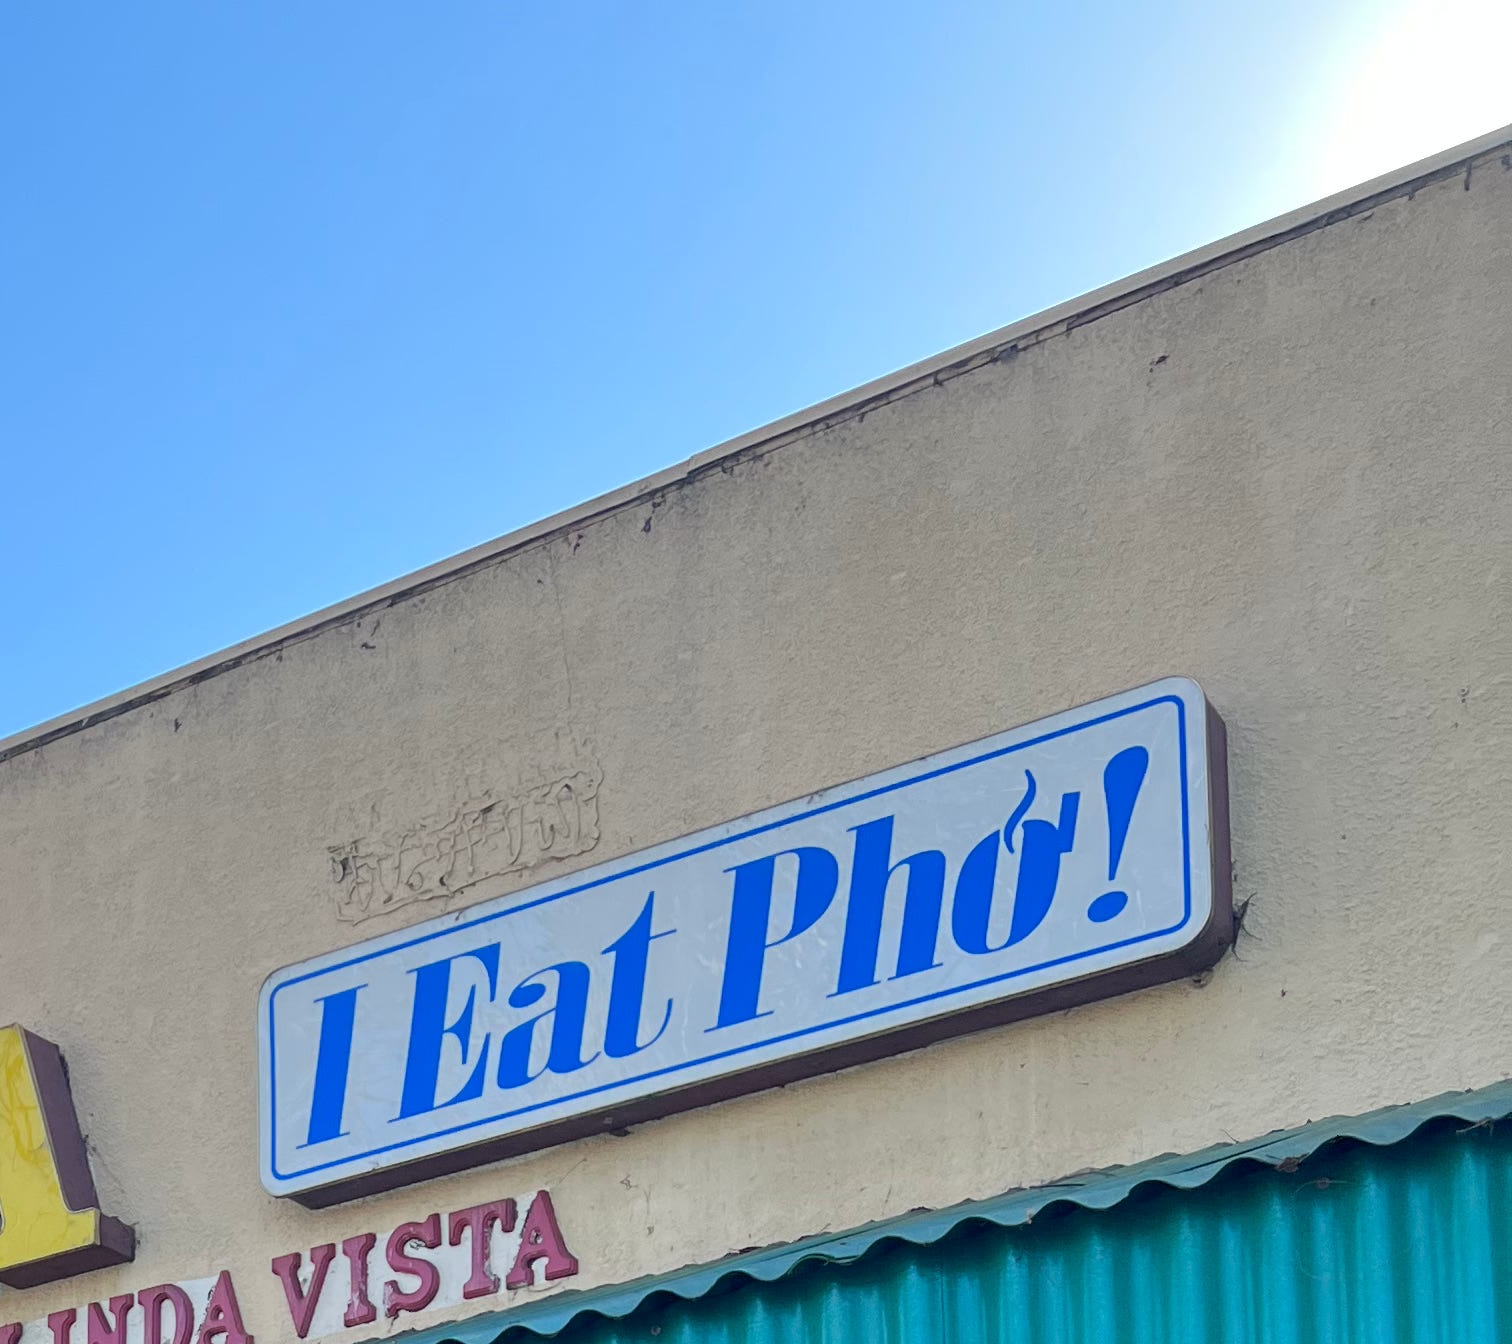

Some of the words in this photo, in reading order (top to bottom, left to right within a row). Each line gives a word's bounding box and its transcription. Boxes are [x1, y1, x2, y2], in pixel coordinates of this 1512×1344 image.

[295, 986, 369, 1149] I
[386, 889, 676, 1123] Eat
[271, 1190, 579, 1339] VISTA
